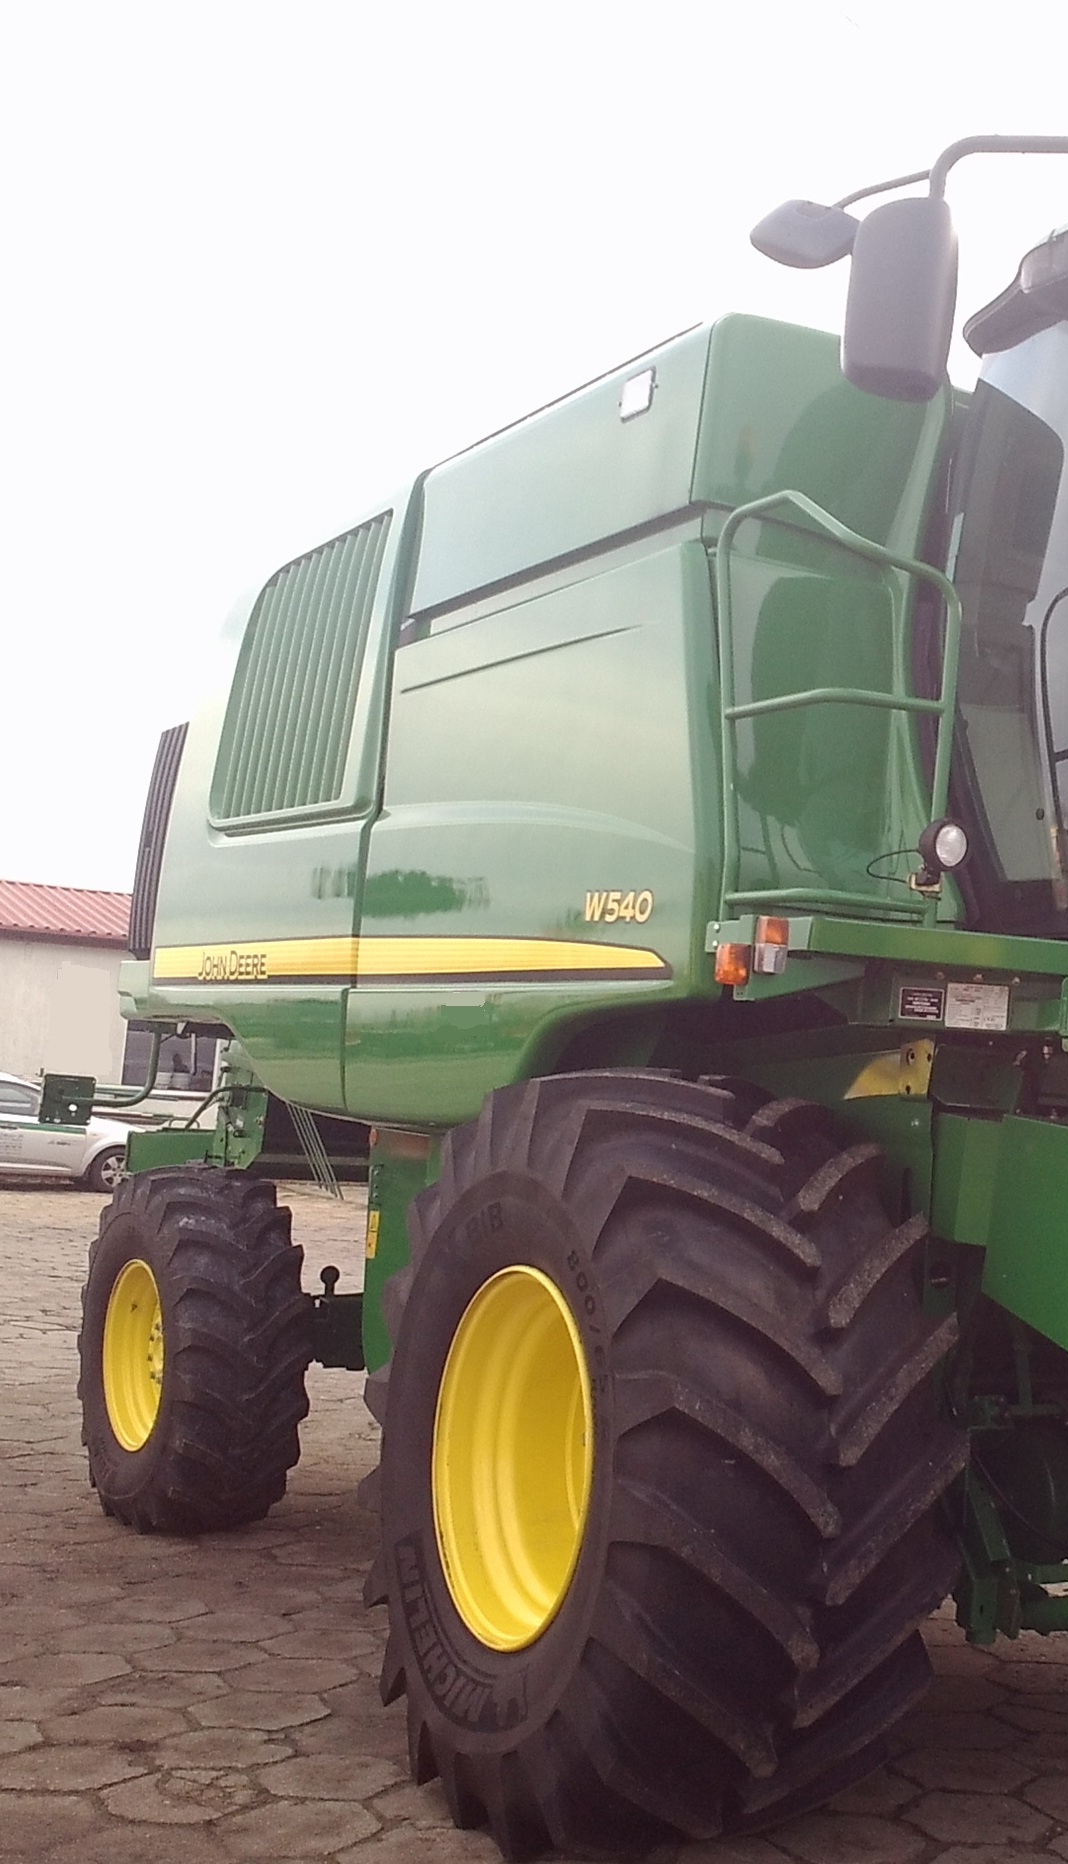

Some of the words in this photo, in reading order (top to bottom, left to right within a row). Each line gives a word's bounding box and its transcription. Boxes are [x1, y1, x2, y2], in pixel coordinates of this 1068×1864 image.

[585, 889, 654, 924] W540
[198, 951, 227, 979] JOHN
[229, 950, 268, 979] DEERE
[396, 1544, 491, 1722] MICHELIN
